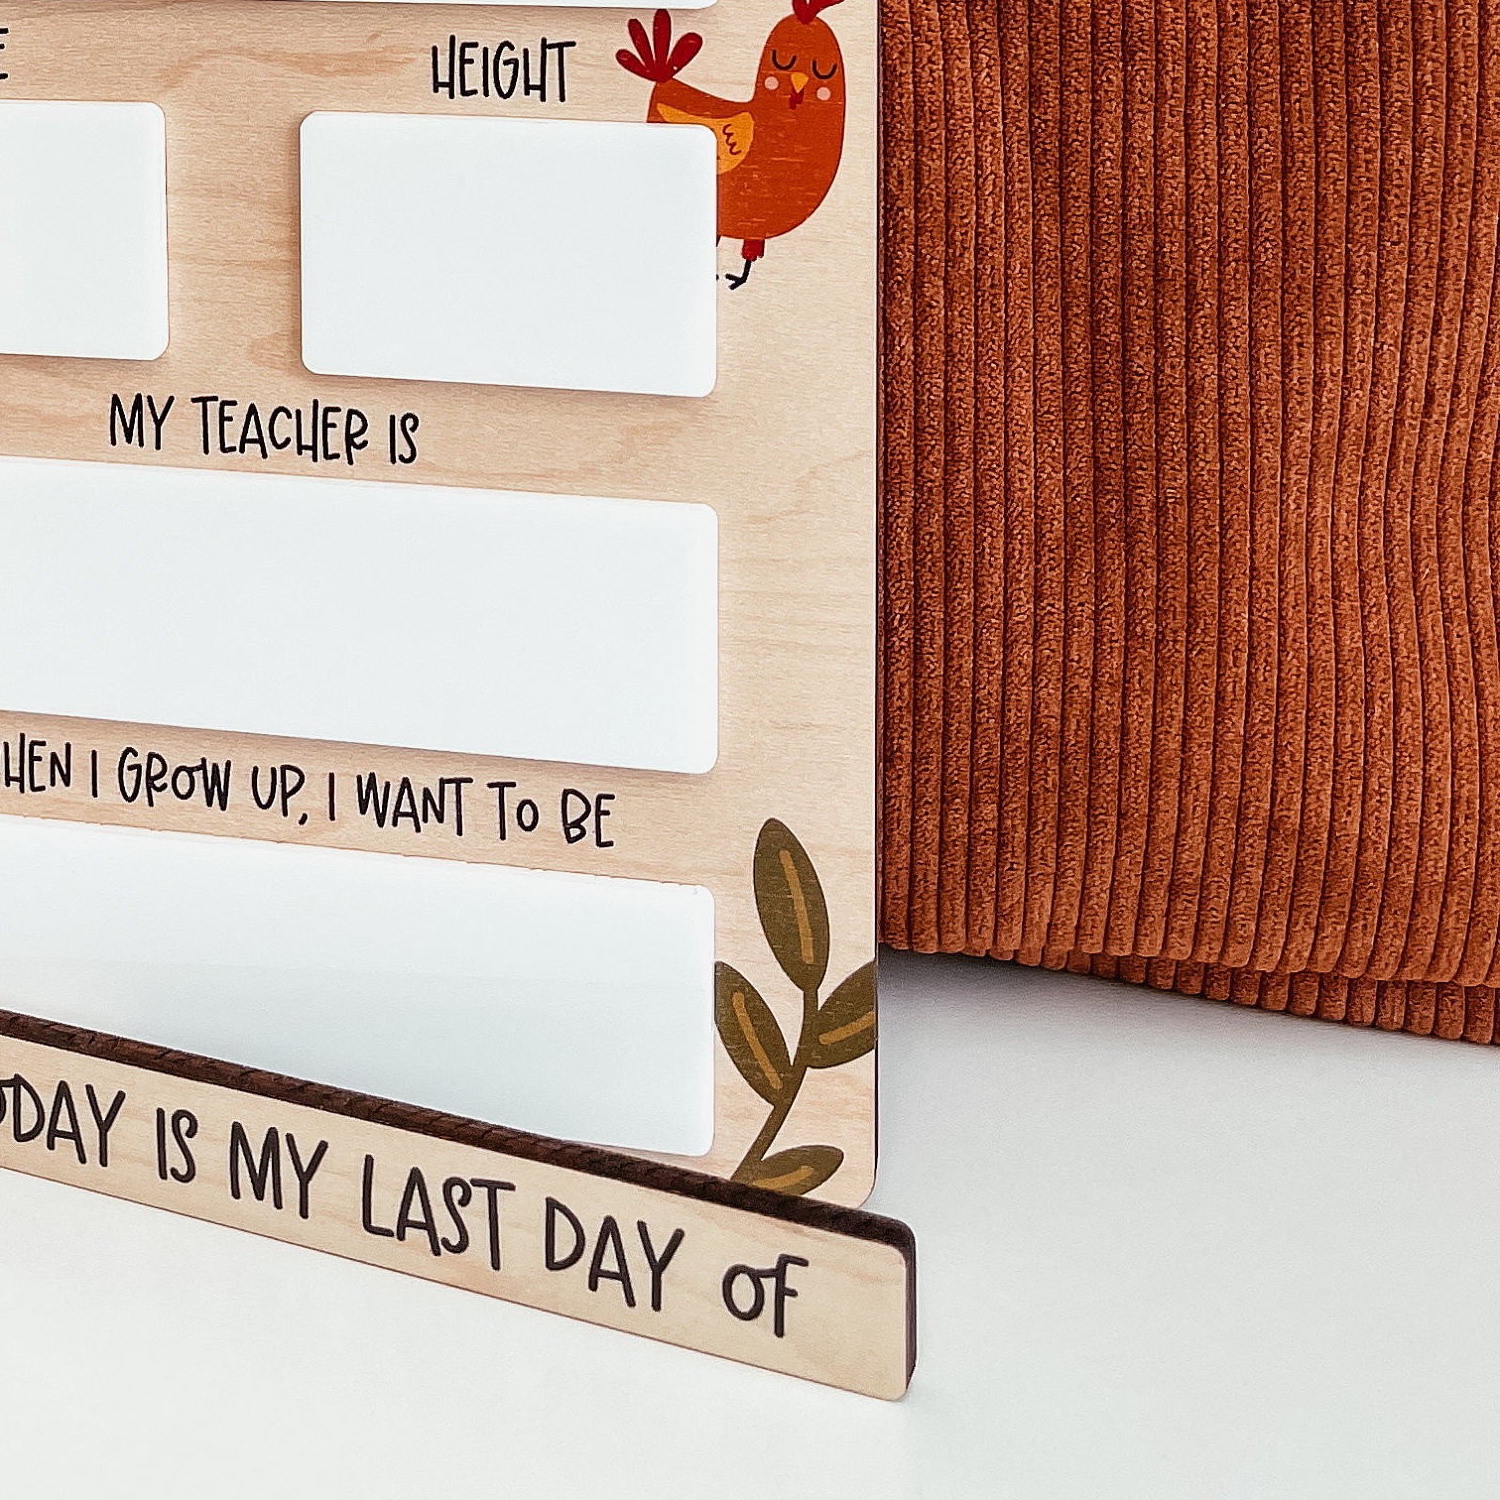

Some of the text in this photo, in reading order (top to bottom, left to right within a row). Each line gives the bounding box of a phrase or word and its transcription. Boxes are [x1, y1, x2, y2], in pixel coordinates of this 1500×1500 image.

[431, 34, 577, 103] HEIGHT
[109, 392, 420, 466] MY TEACHER IS
[91, 749, 98, 798] I
[251, 764, 308, 826] UP,
[328, 772, 336, 822] I
[356, 771, 474, 837] WANT
[560, 788, 616, 848] BE
[156, 1107, 198, 1184] IS
[229, 1120, 329, 1220] MY
[361, 1152, 515, 1272] LAST
[544, 1195, 685, 1313] DAY
